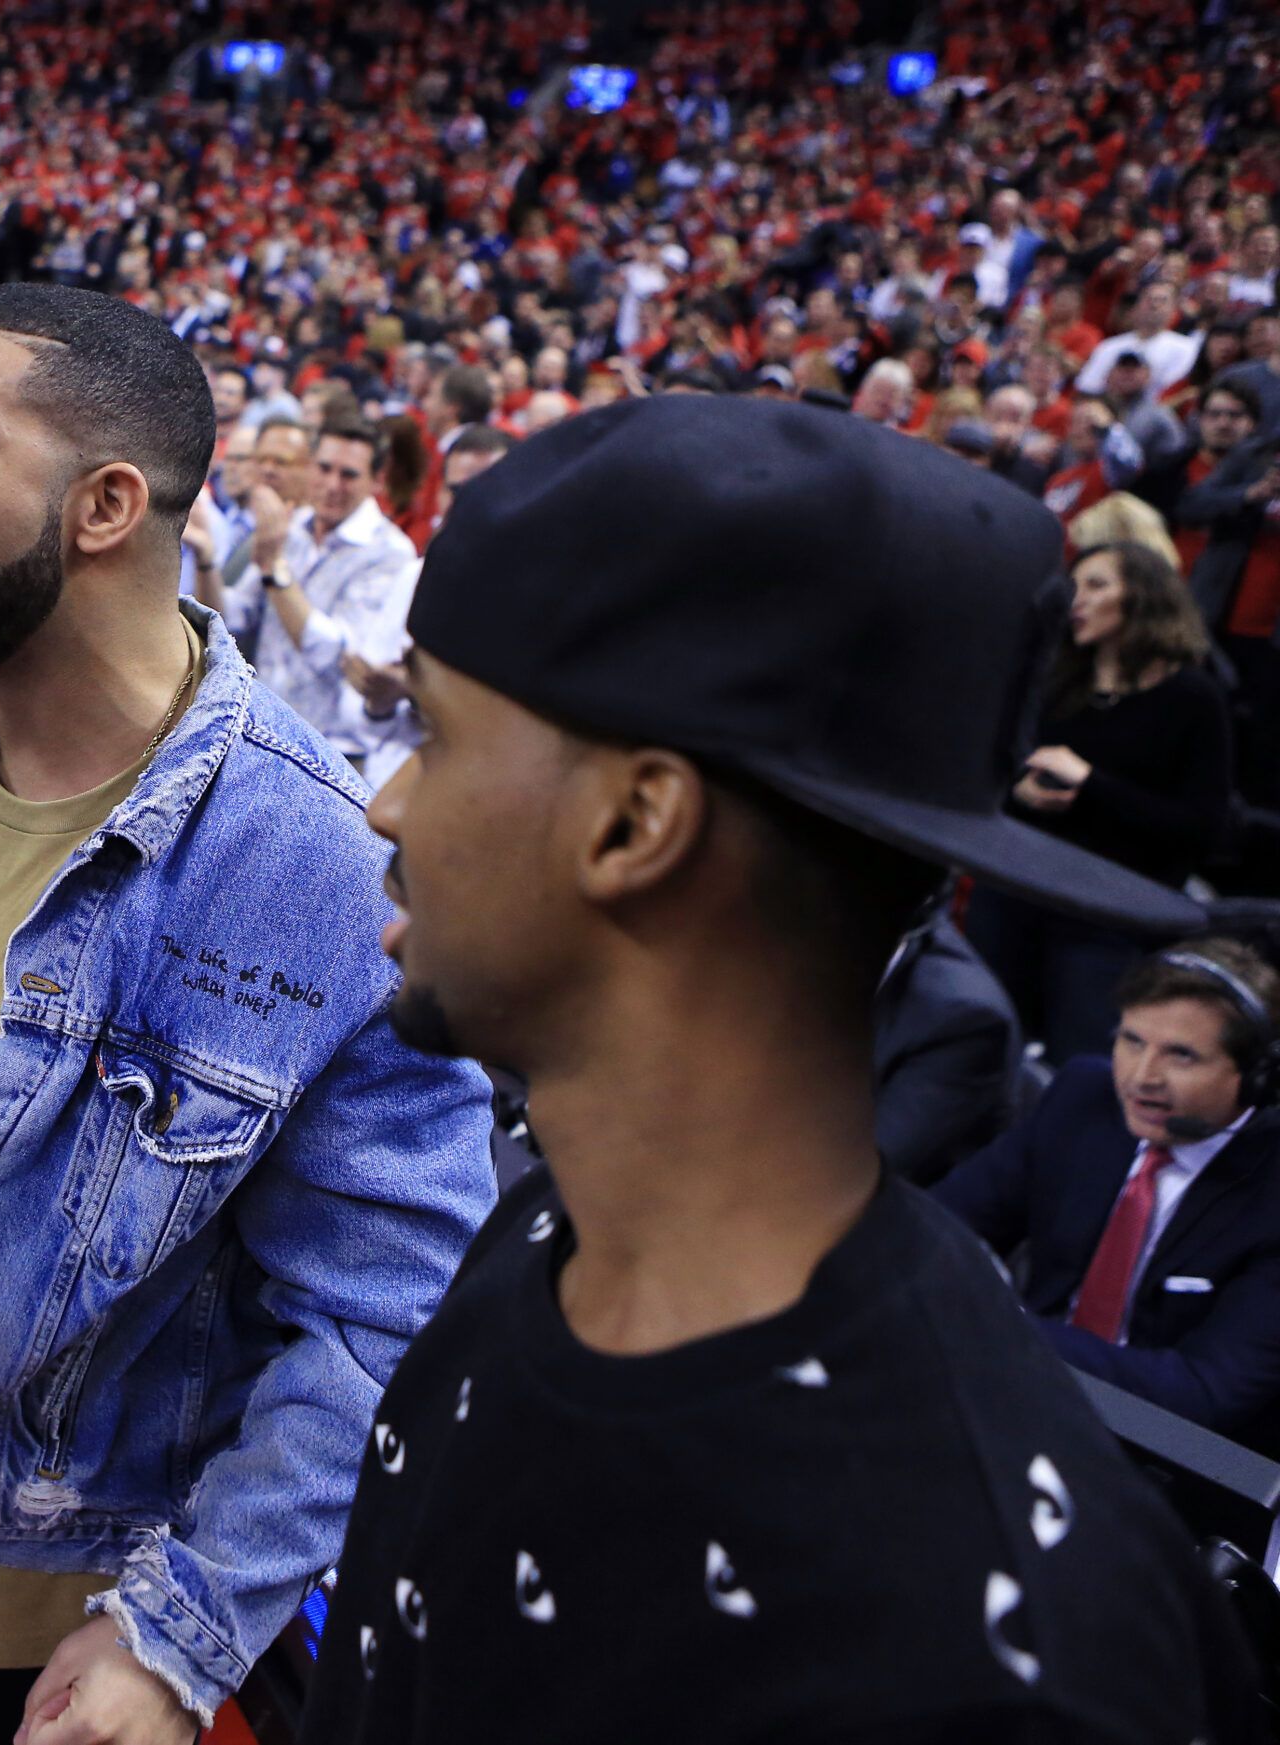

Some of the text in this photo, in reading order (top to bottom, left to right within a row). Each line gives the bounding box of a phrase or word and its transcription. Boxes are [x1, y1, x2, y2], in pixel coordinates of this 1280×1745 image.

[159, 934, 324, 1009] The Life of Pablo
